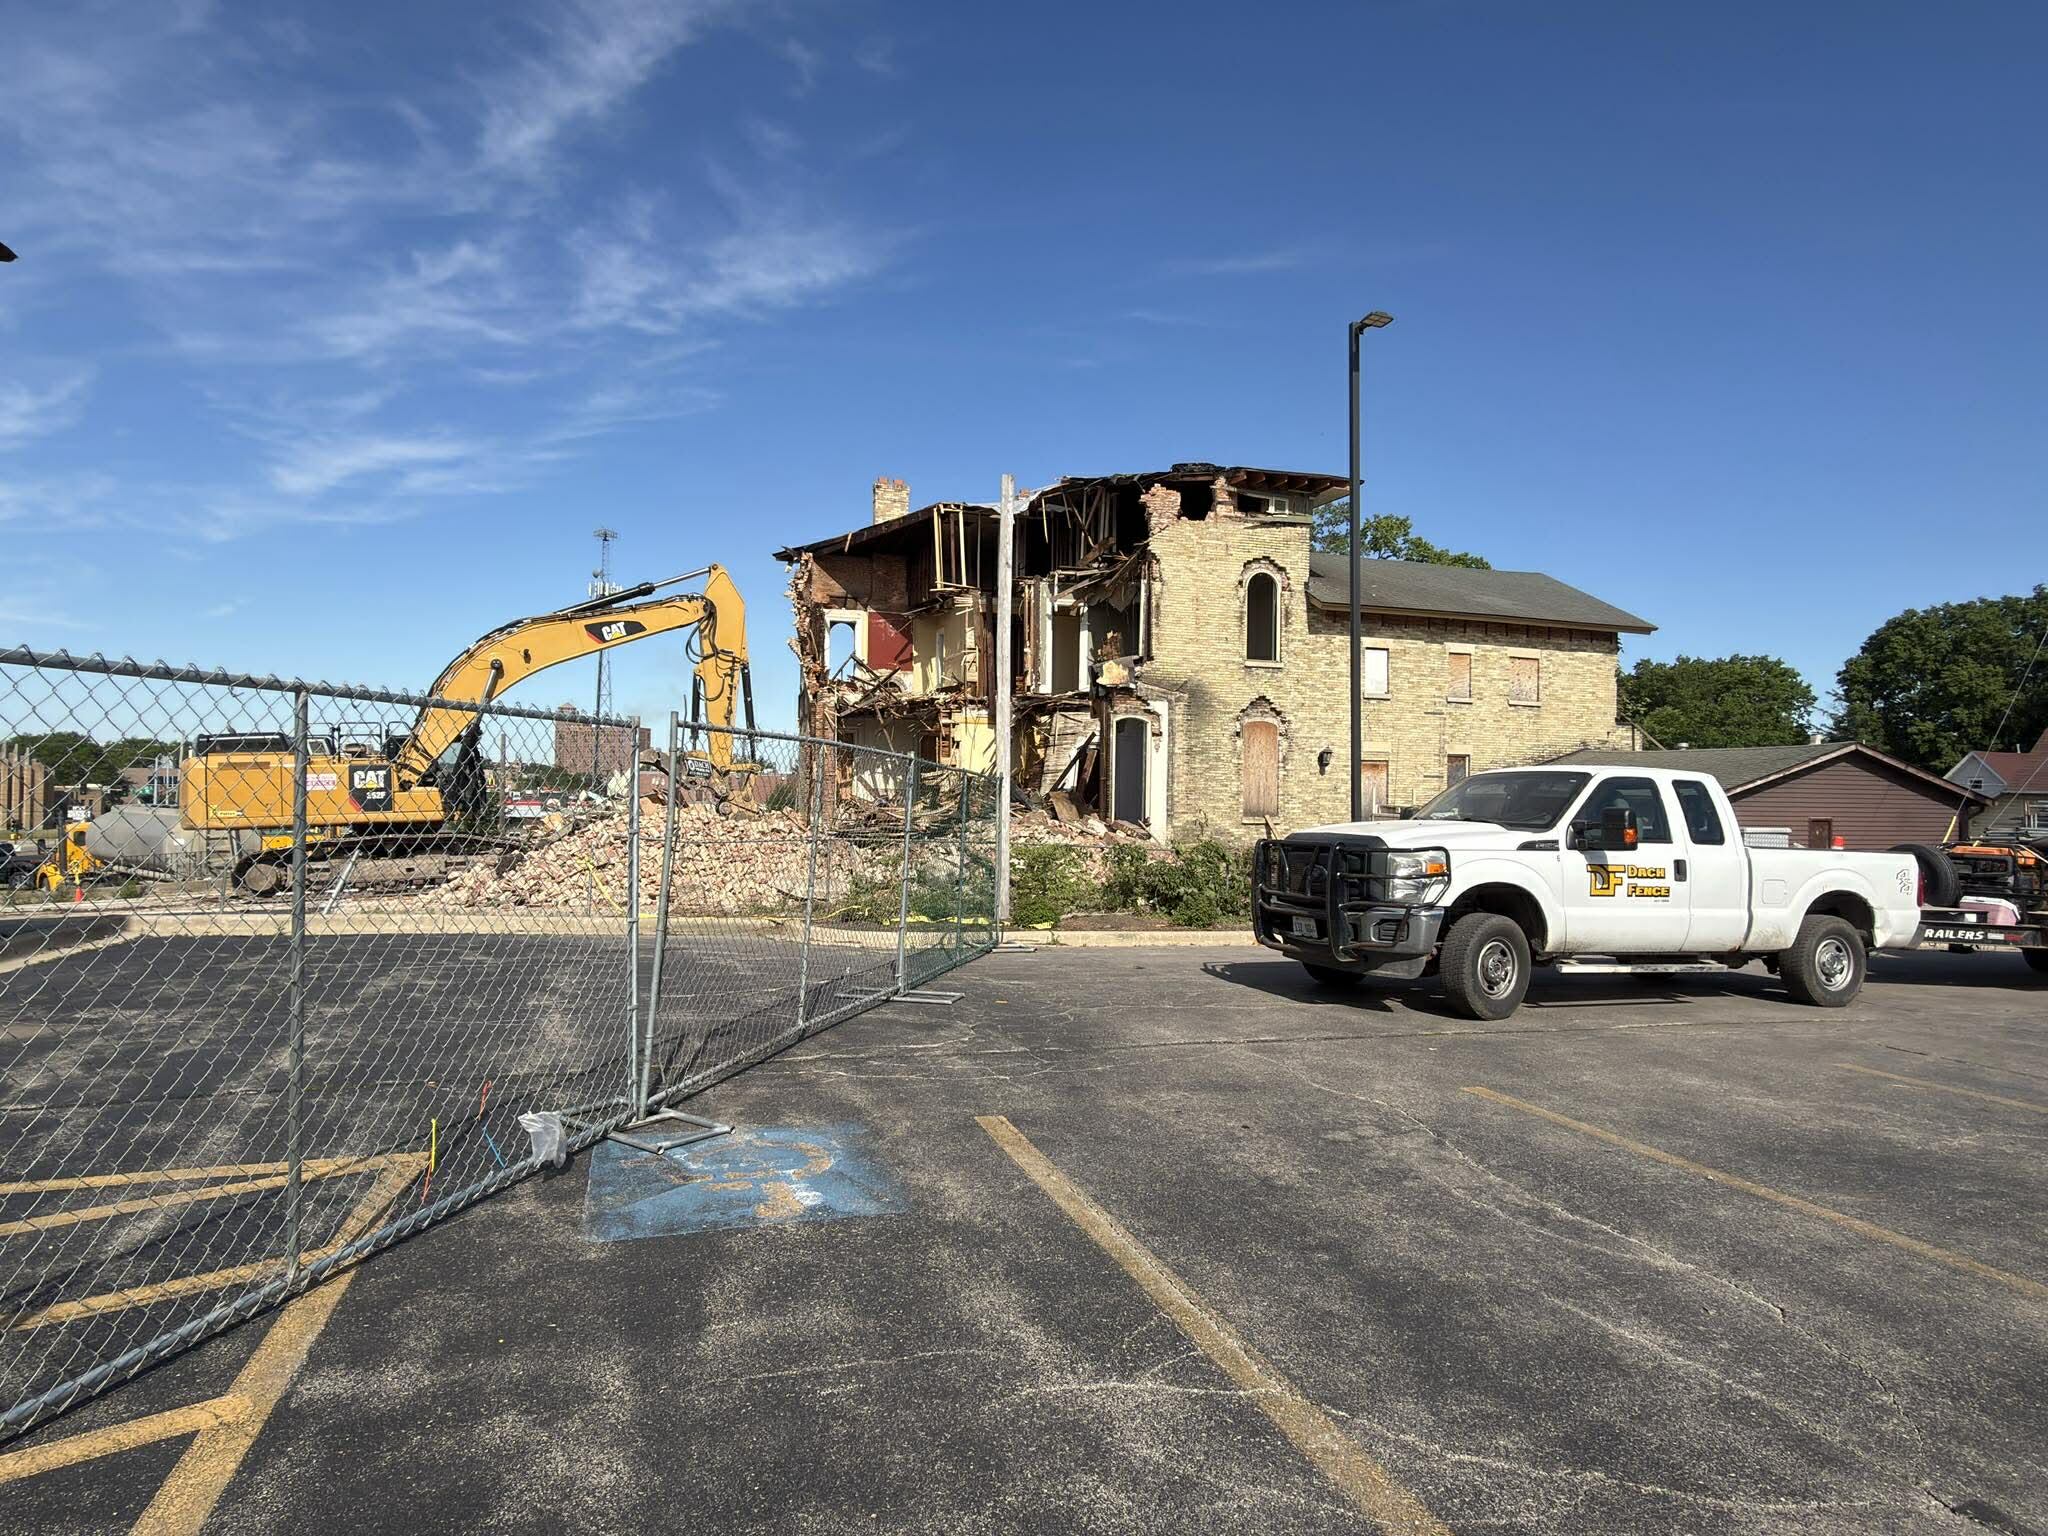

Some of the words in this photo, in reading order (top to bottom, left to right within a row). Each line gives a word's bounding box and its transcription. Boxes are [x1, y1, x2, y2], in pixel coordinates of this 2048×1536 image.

[601, 621, 627, 641] CAT
[353, 770, 386, 789] CAT
[1627, 864, 1666, 879] DACH
[1627, 883, 1670, 897] FENCE
[1924, 928, 1985, 940] RAILERS
